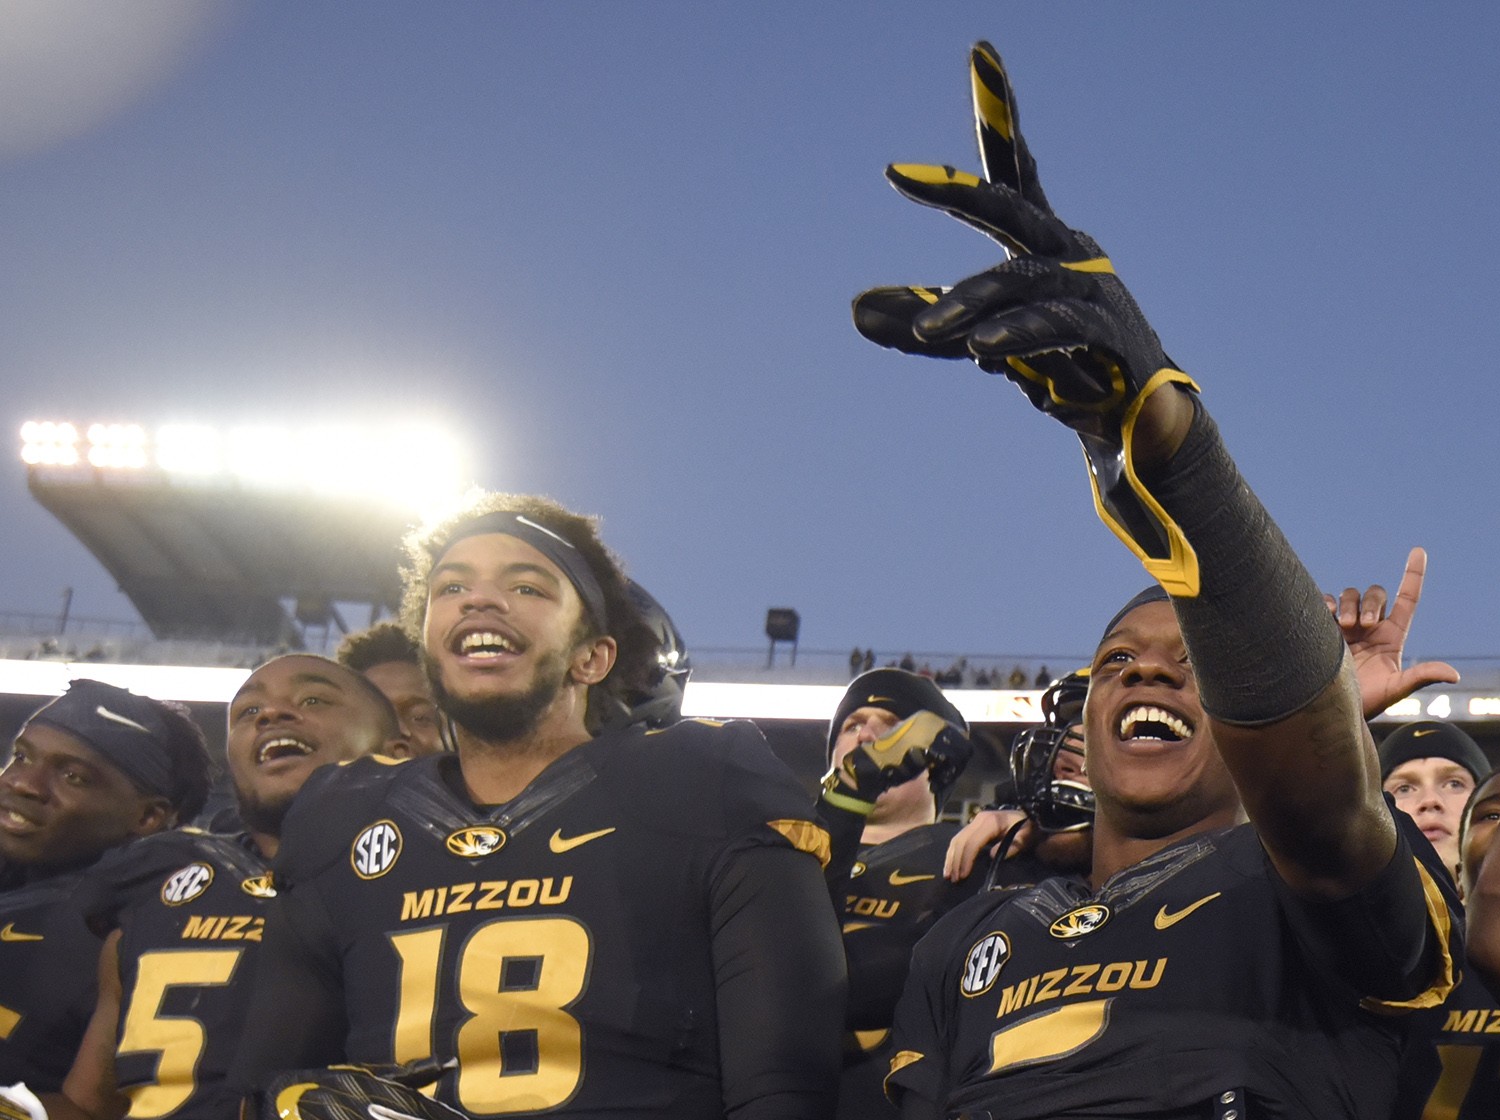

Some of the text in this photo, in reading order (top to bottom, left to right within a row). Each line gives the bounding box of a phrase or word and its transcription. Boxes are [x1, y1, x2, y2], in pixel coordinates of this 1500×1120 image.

[354, 824, 400, 876] SEC
[164, 865, 210, 903] SEC
[402, 876, 572, 921] MIZZOU
[965, 936, 1009, 994] SEC
[997, 958, 1168, 1019] MIZZOU
[117, 948, 245, 1120] 5
[387, 917, 594, 1117] 18
